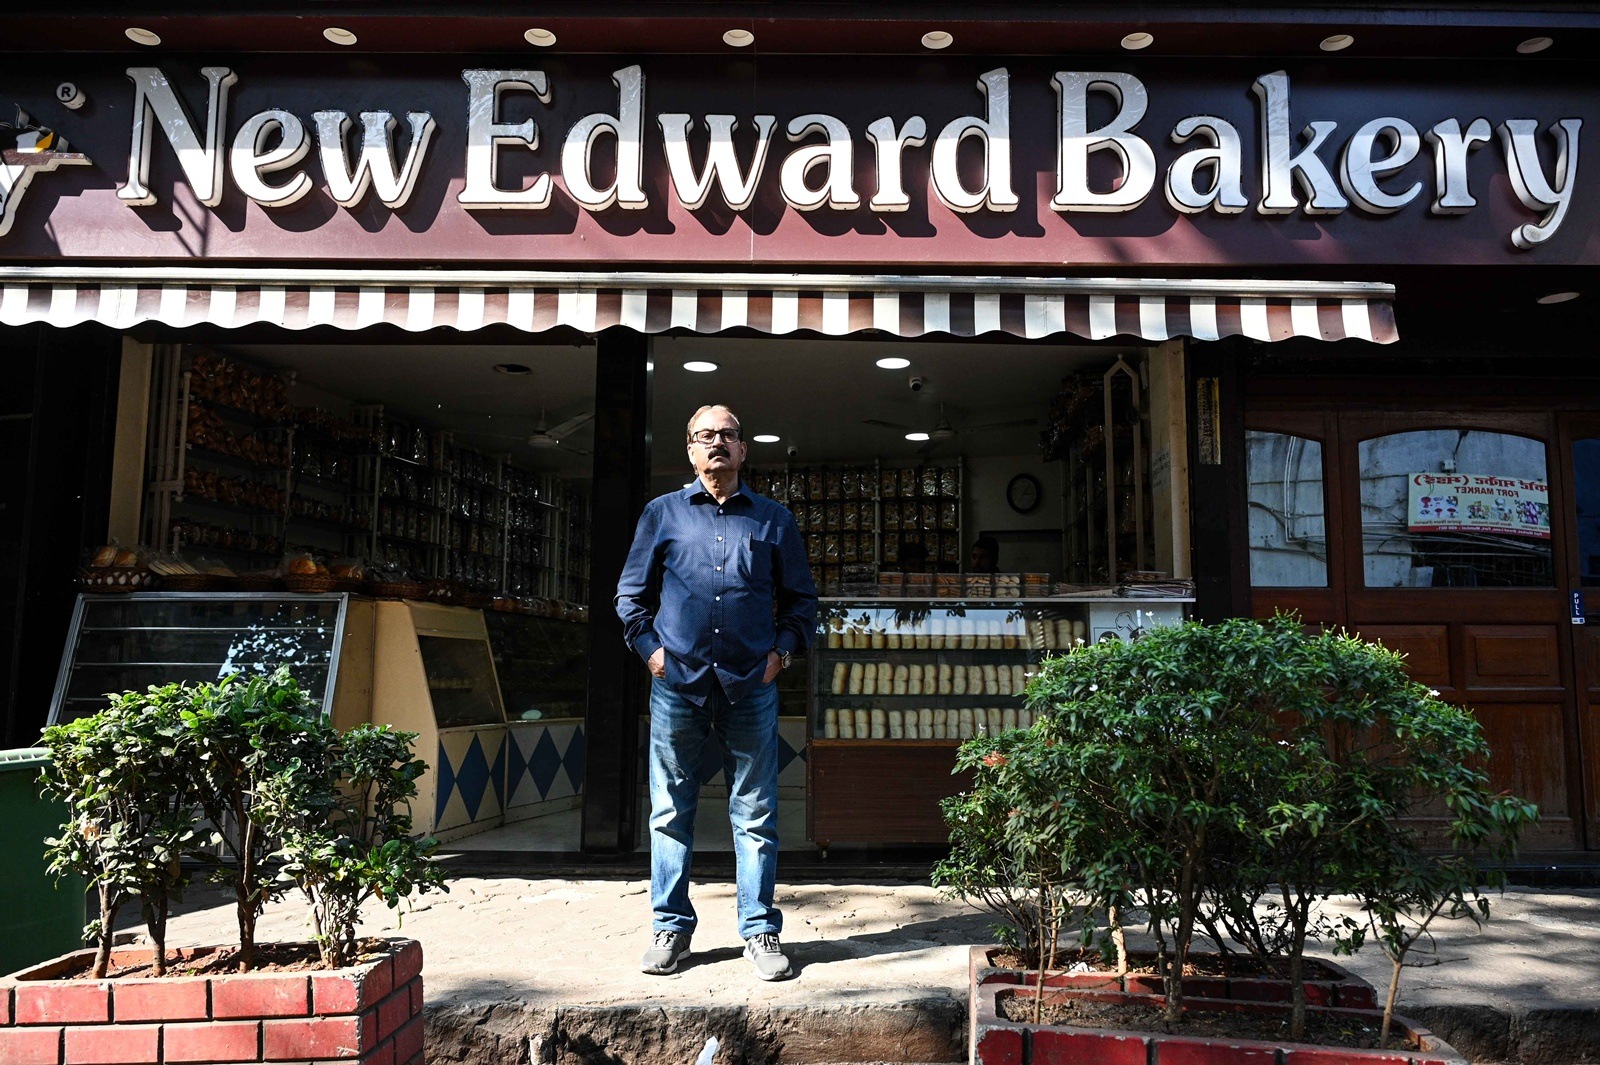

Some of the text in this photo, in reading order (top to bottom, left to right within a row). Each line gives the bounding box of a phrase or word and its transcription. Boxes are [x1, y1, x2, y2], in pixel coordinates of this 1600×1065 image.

[115, 64, 1584, 251] New Edward Bakery
